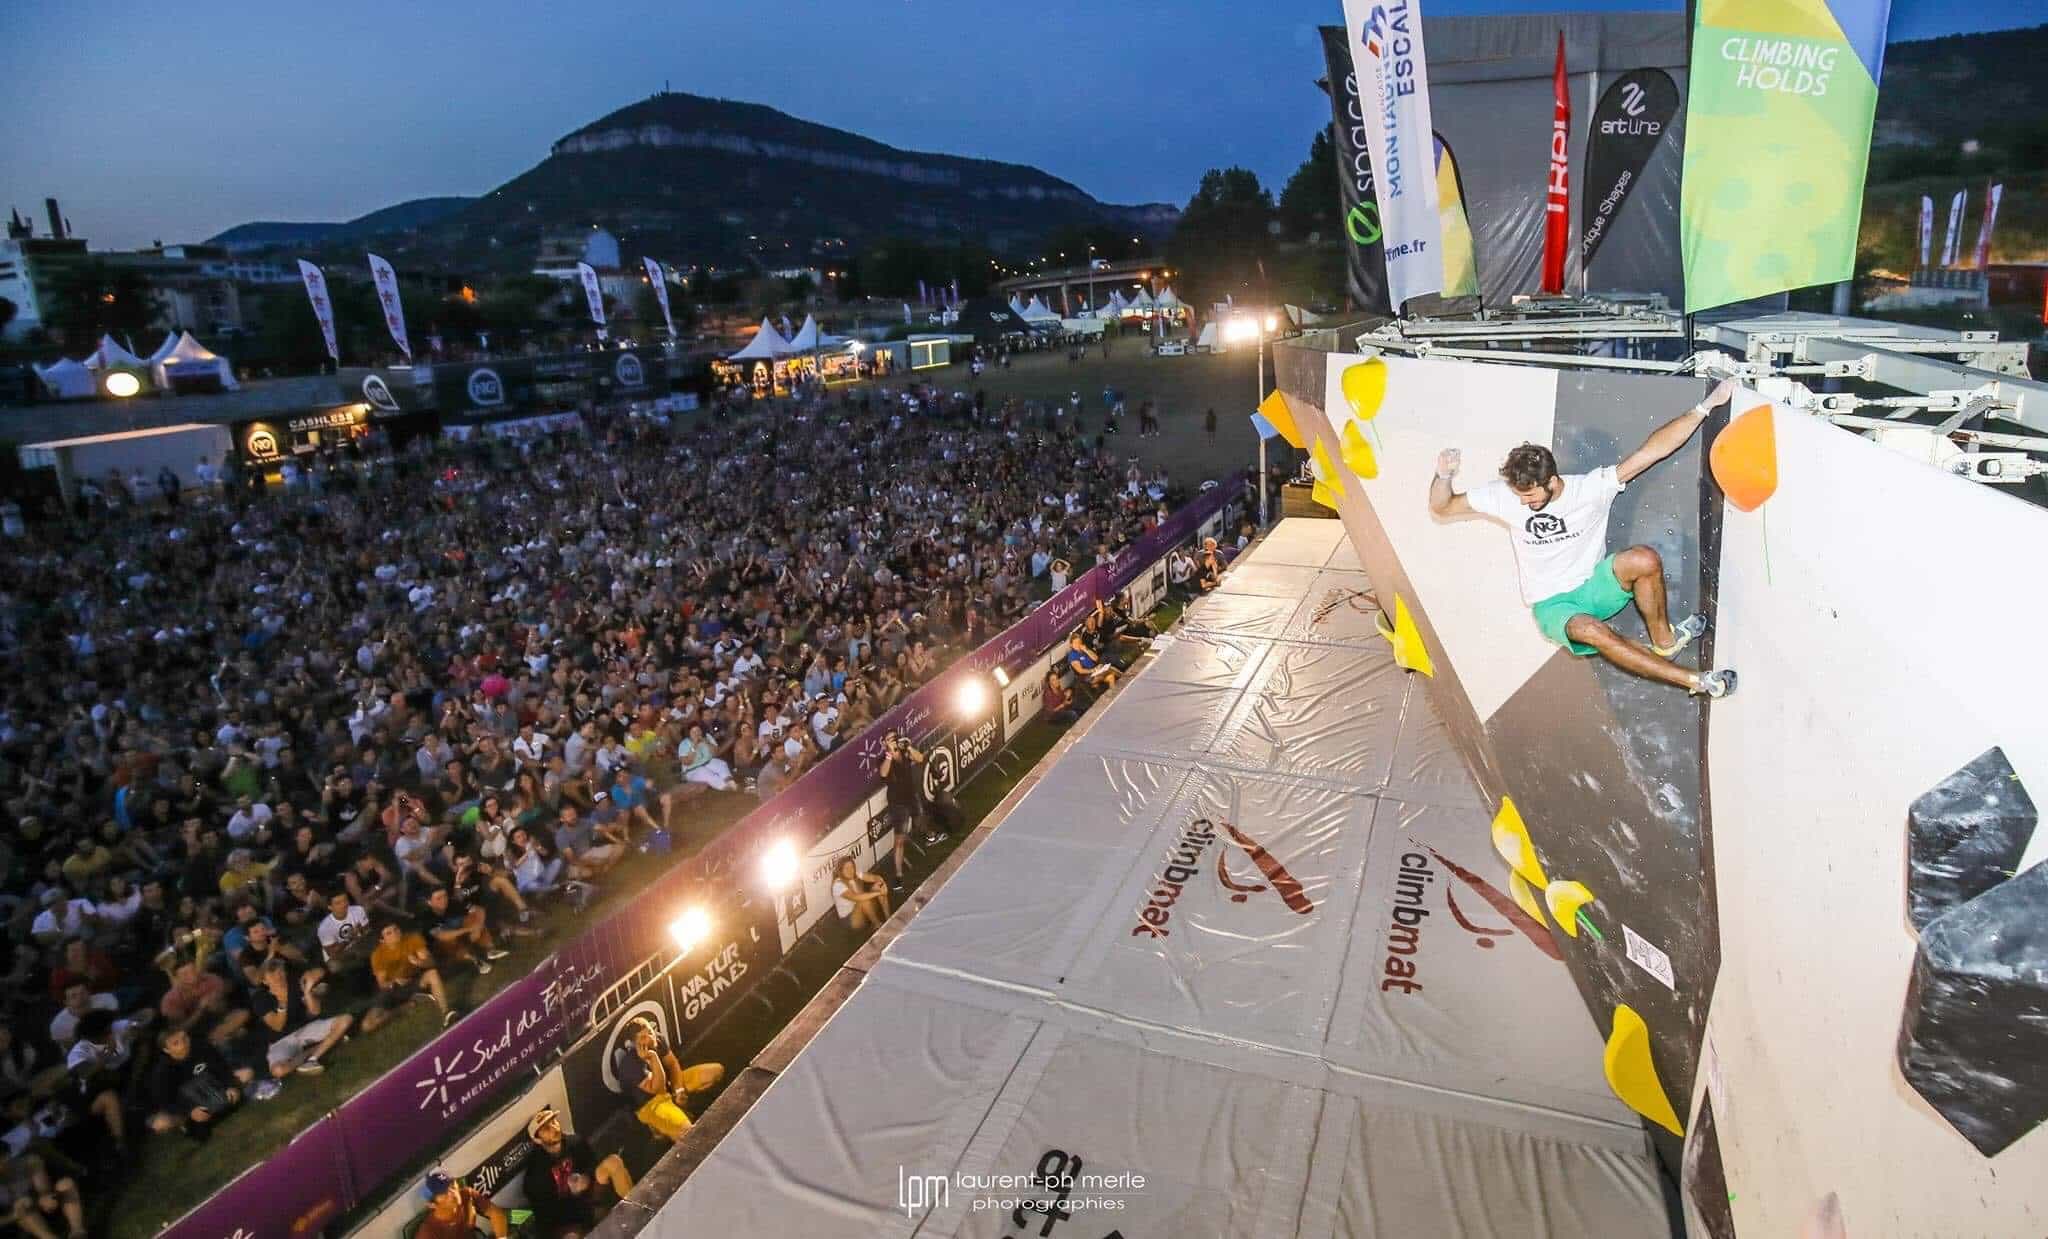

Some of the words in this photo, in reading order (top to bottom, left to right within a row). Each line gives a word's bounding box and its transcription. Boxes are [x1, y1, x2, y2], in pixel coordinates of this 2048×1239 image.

[1721, 38, 1839, 72] CLIMBING
[1737, 65, 1829, 96] HOLDS
[1600, 169, 1632, 215] Shapes
[289, 412, 355, 429] CASHLESS
[1533, 522, 1559, 534] NG
[1132, 818, 1214, 939] climbmat
[1381, 851, 1434, 994] climbmat
[681, 926, 760, 1005] NATURL
[685, 960, 749, 1020] GAMES
[469, 1019, 512, 1073] Sud
[516, 1010, 542, 1034] de
[442, 1102, 457, 1119] LE
[460, 1056, 519, 1105] MEILLEUR
[520, 1044, 537, 1060] DE
